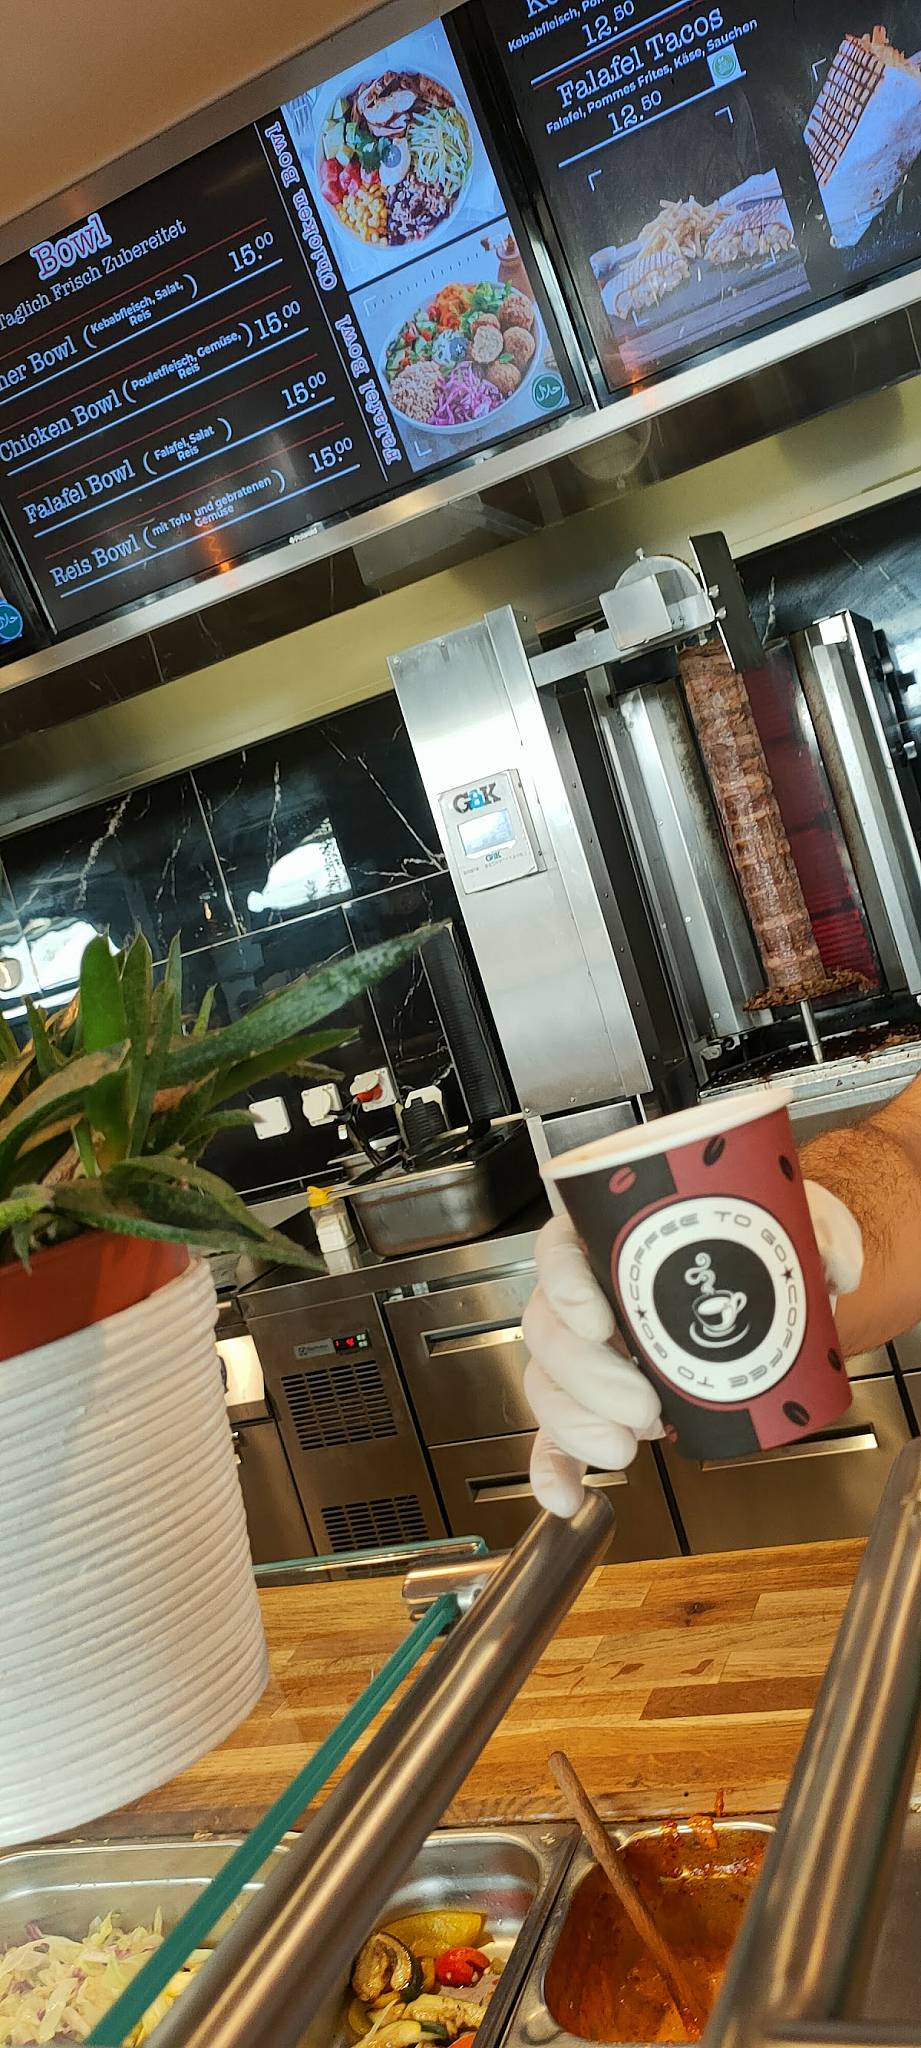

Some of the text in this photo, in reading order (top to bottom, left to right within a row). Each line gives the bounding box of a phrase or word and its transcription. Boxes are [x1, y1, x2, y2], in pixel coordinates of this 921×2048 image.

[507, 7, 581, 53] Kebabfleisch,
[556, 7, 725, 109] Falafel Tacos
[582, 0, 634, 47] 12.50
[546, 18, 758, 135] Falafel, Pommes Frites, Käse, Sauchen
[607, 90, 663, 135] 12.50
[30, 213, 112, 280] Bowl
[264, 120, 337, 291] Chicken Bowl
[27, 335, 78, 374] Bowl
[228, 231, 274, 272] 15.00
[50, 265, 103, 302] Frisch
[102, 219, 187, 274] Zubereitet
[128, 309, 152, 327] Reis
[0, 417, 74, 462] Chicken
[70, 389, 122, 427] Bowl
[254, 300, 301, 340] 15.00
[177, 362, 200, 380] Reis
[334, 313, 402, 465] Falafel Bowl
[22, 481, 88, 525] Falafel
[85, 459, 136, 496] Bowl
[189, 425, 215, 445] Salat
[280, 371, 327, 410] 15.00
[176, 445, 200, 462] Reis
[49, 558, 93, 587] Reis
[91, 534, 141, 568] Bowl
[151, 521, 169, 537] mit
[168, 512, 192, 529] Tofu
[193, 500, 214, 518] und
[214, 476, 272, 510] gebratenen
[308, 437, 353, 474] 15.00
[193, 504, 234, 528] Gemüse
[629, 1210, 787, 1301] COFFEE TO GO
[641, 1284, 798, 1389] COFFEE TO GO
